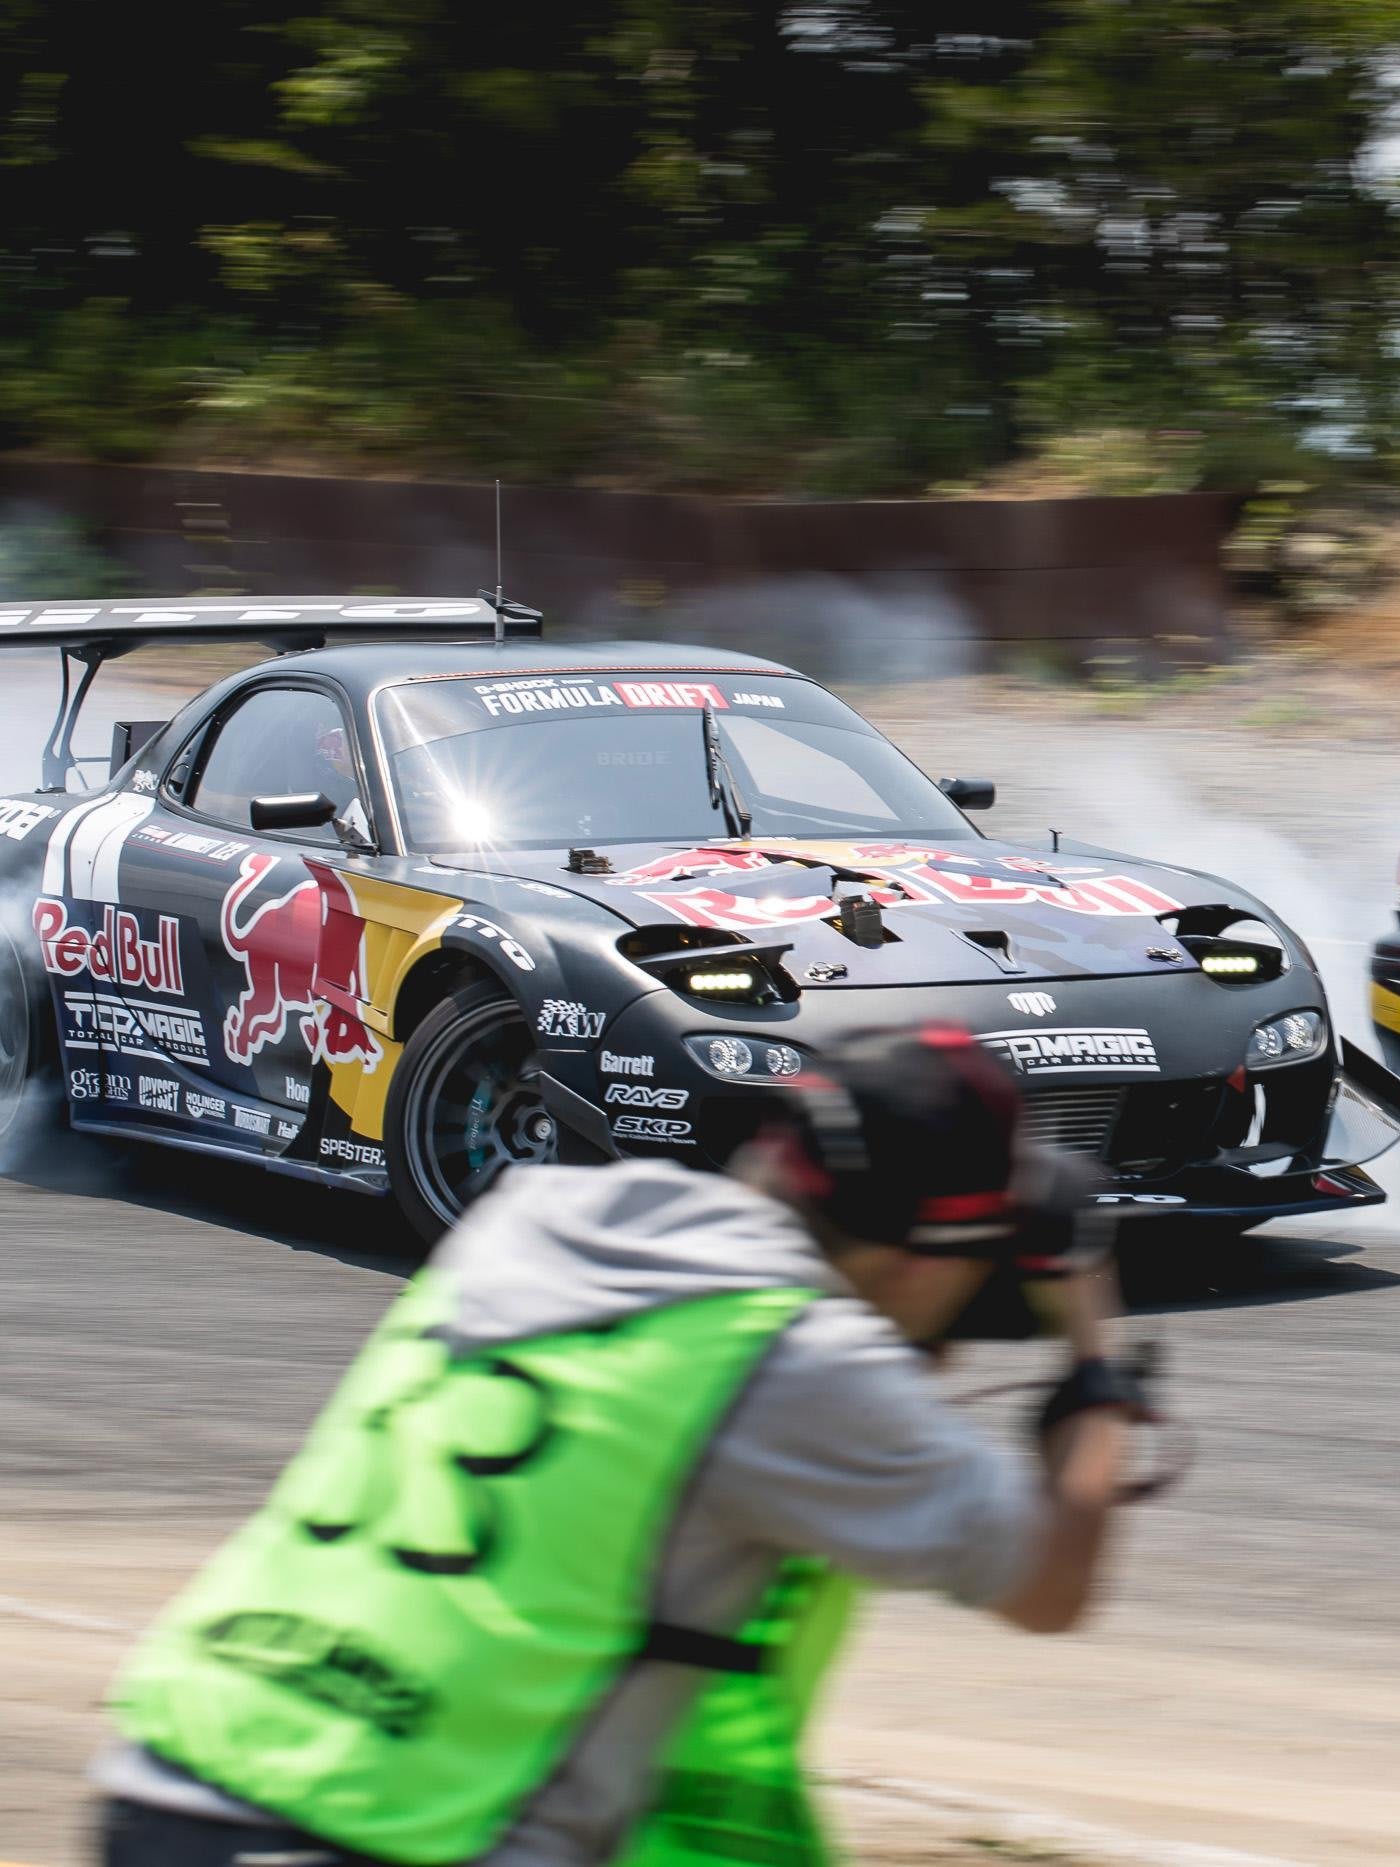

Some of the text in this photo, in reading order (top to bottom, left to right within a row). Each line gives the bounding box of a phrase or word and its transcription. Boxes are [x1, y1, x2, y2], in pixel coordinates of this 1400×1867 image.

[480, 683, 785, 716] FORMULA DRIFT JAPAN
[33, 897, 184, 996] Red Bull
[550, 1013, 606, 1038] KW
[601, 1051, 655, 1077] Garrett
[1026, 1055, 1157, 1066] CAR PRODUCE
[70, 1068, 132, 1099] gram
[605, 1083, 690, 1110] RAYS
[186, 1091, 226, 1112] HOLINGER
[613, 1115, 692, 1137] SKP
